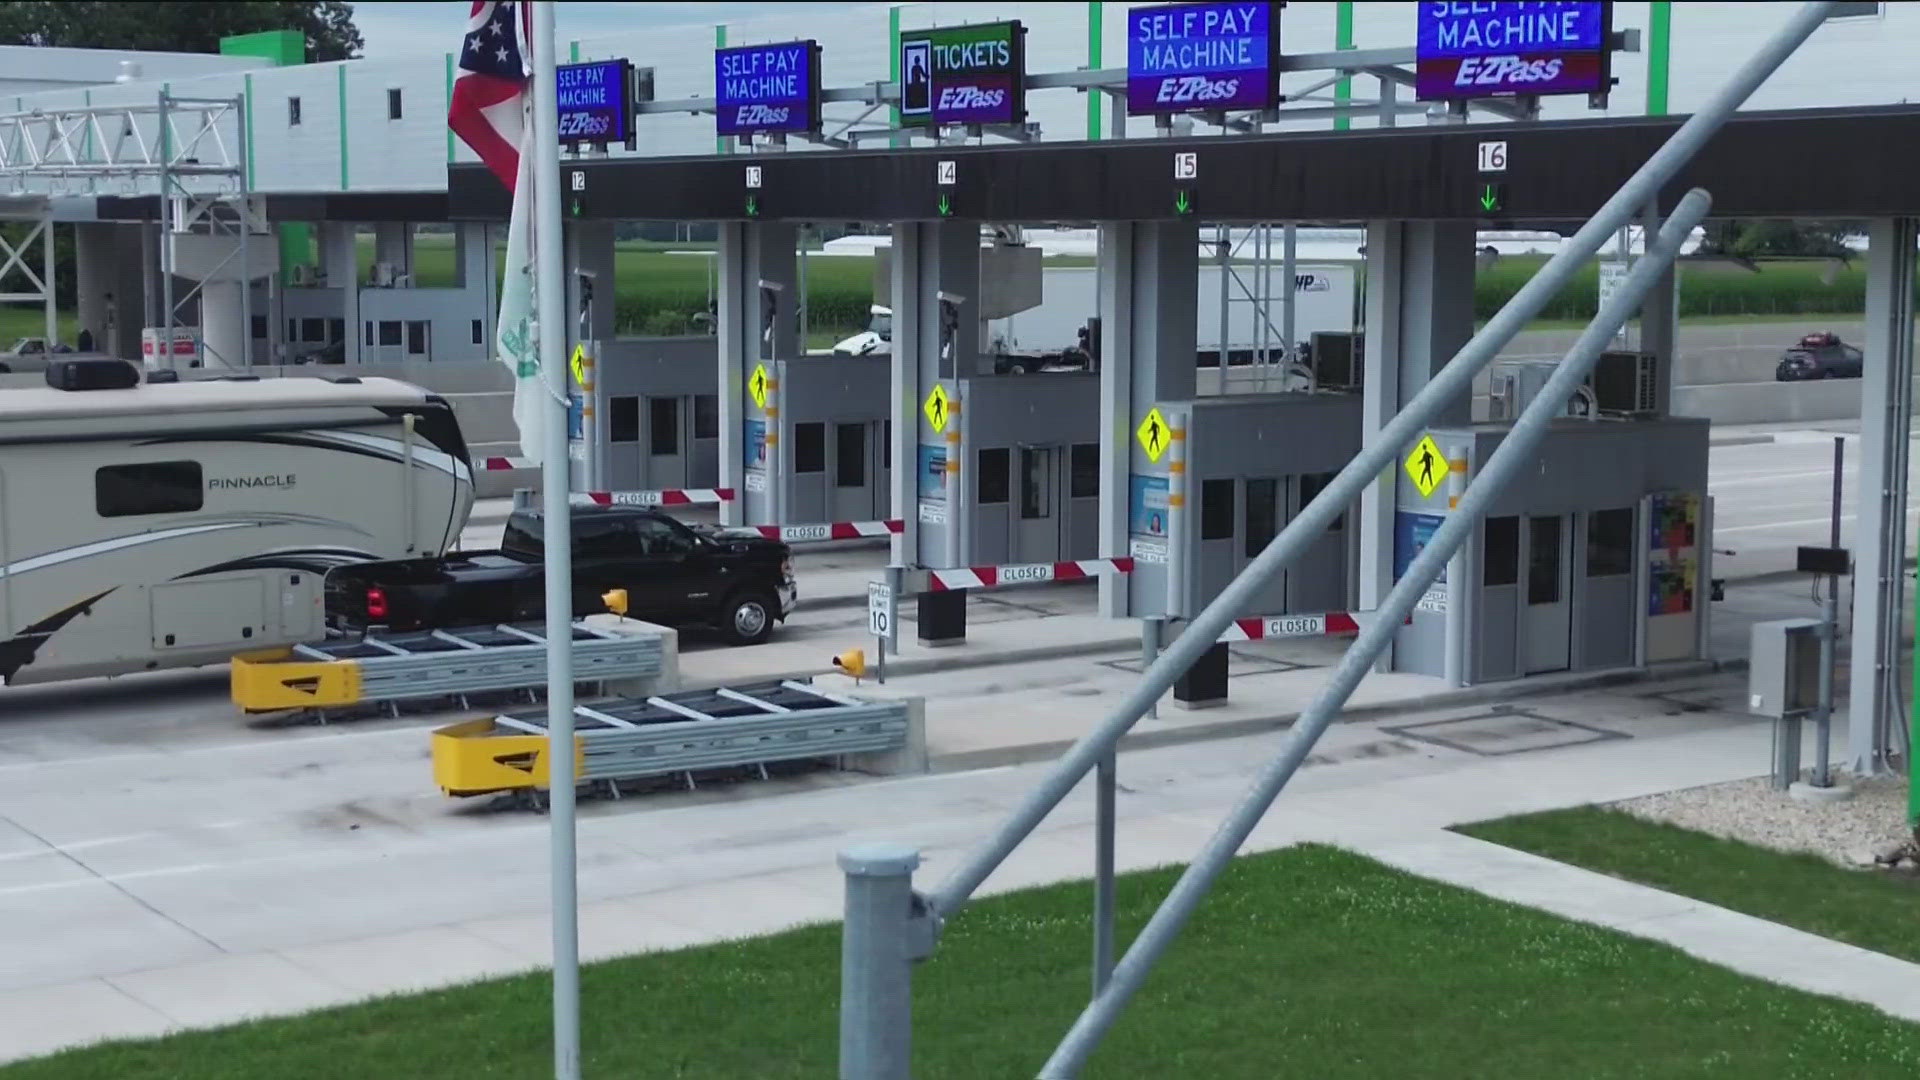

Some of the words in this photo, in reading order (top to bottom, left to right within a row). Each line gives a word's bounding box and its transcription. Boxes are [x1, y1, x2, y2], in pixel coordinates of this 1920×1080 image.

[1139, 12, 1198, 43] SELF
[1204, 6, 1257, 36] PAY
[1437, 11, 1580, 49] MACHINE
[722, 53, 761, 77] SELF
[765, 49, 799, 72] PAY
[933, 39, 1010, 69] TICKETS
[1143, 37, 1252, 70] MACHINE
[559, 69, 582, 88] SELF
[586, 67, 605, 85] PAY
[725, 74, 798, 100] MACHINE
[559, 87, 606, 107] MACHINE
[1176, 155, 1195, 177] 15
[1480, 144, 1505, 169] 16
[573, 173, 584, 189] 12
[747, 168, 760, 186] 13
[938, 163, 955, 182] 14
[208, 474, 297, 490] PINNACLE
[786, 526, 826, 538] CLOSED
[1004, 566, 1047, 580] CLOSED
[872, 611, 888, 632] 10
[1270, 618, 1318, 634] CLOSED
